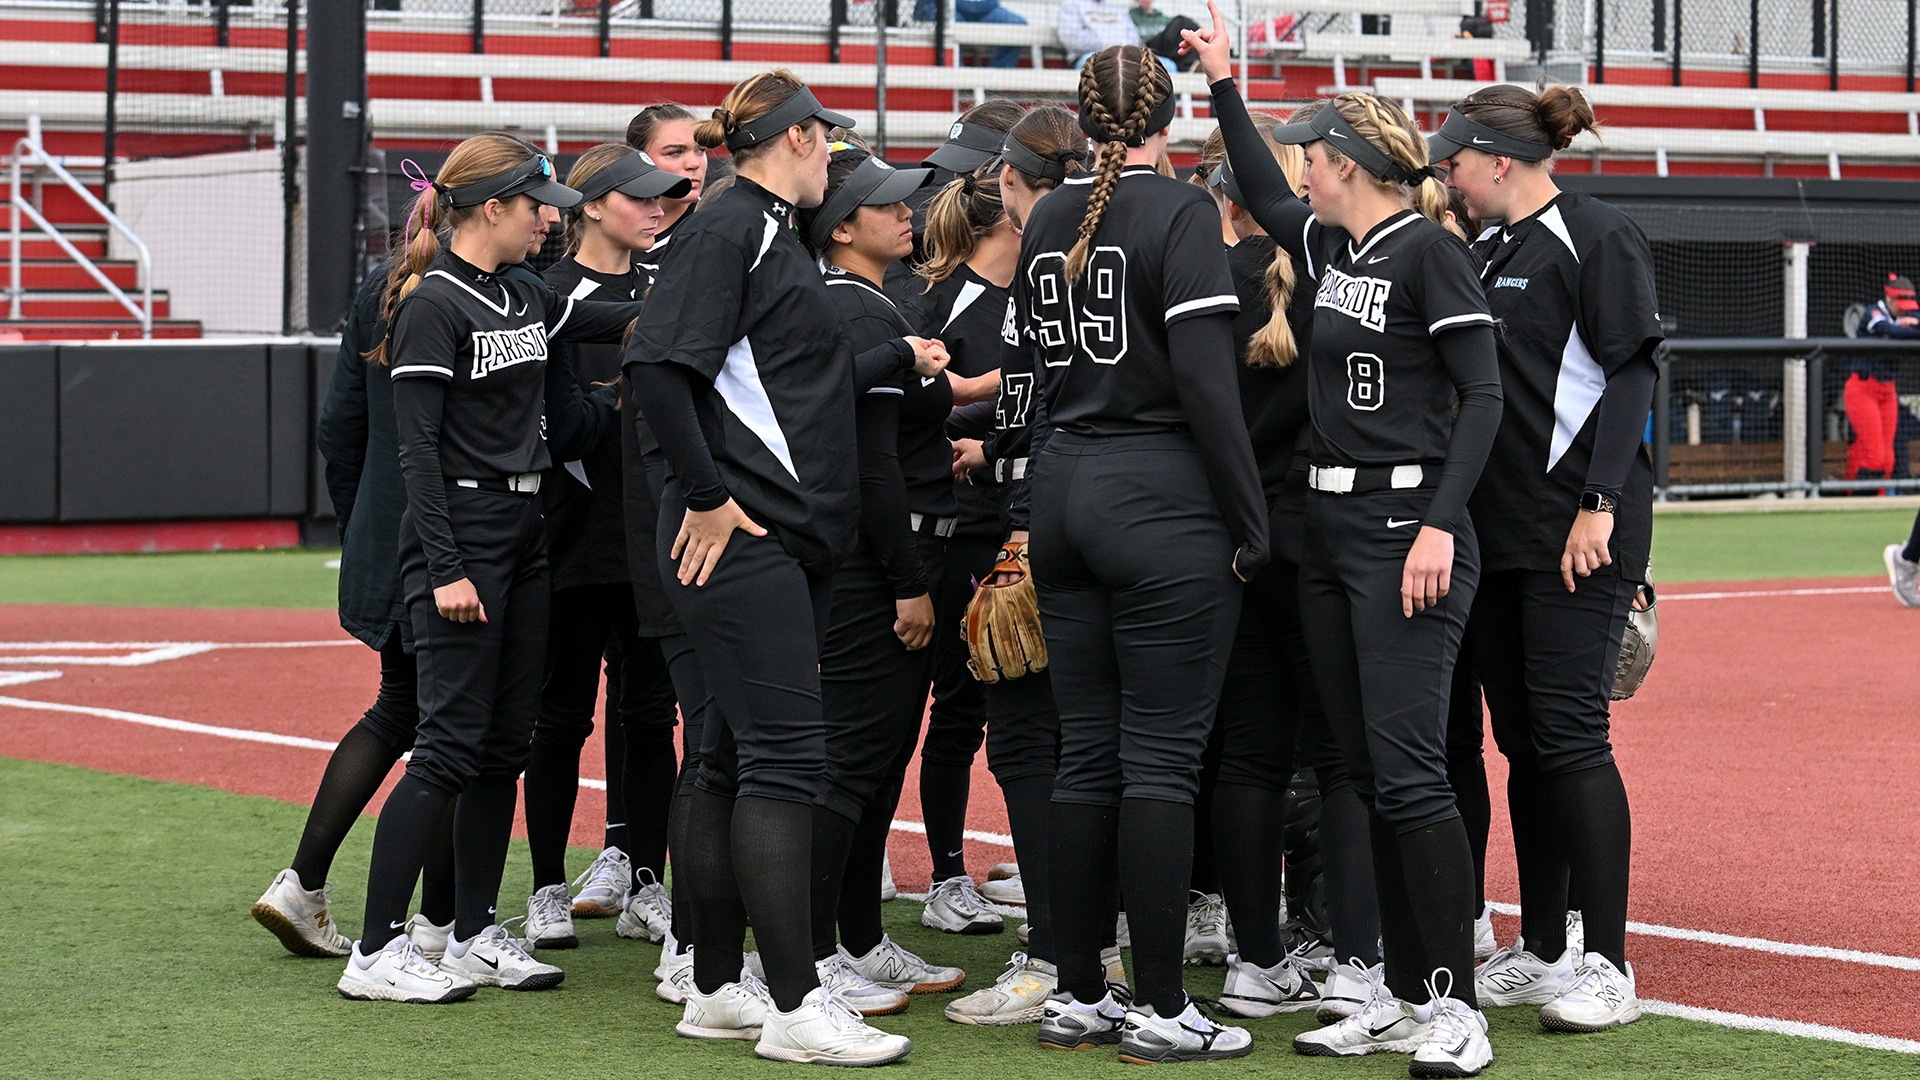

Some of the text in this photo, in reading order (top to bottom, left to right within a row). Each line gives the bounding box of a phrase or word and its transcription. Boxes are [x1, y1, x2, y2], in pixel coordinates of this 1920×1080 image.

[1028, 246, 1128, 368] 99
[1494, 276, 1530, 290] RANGERS
[1346, 352, 1385, 411] 8
